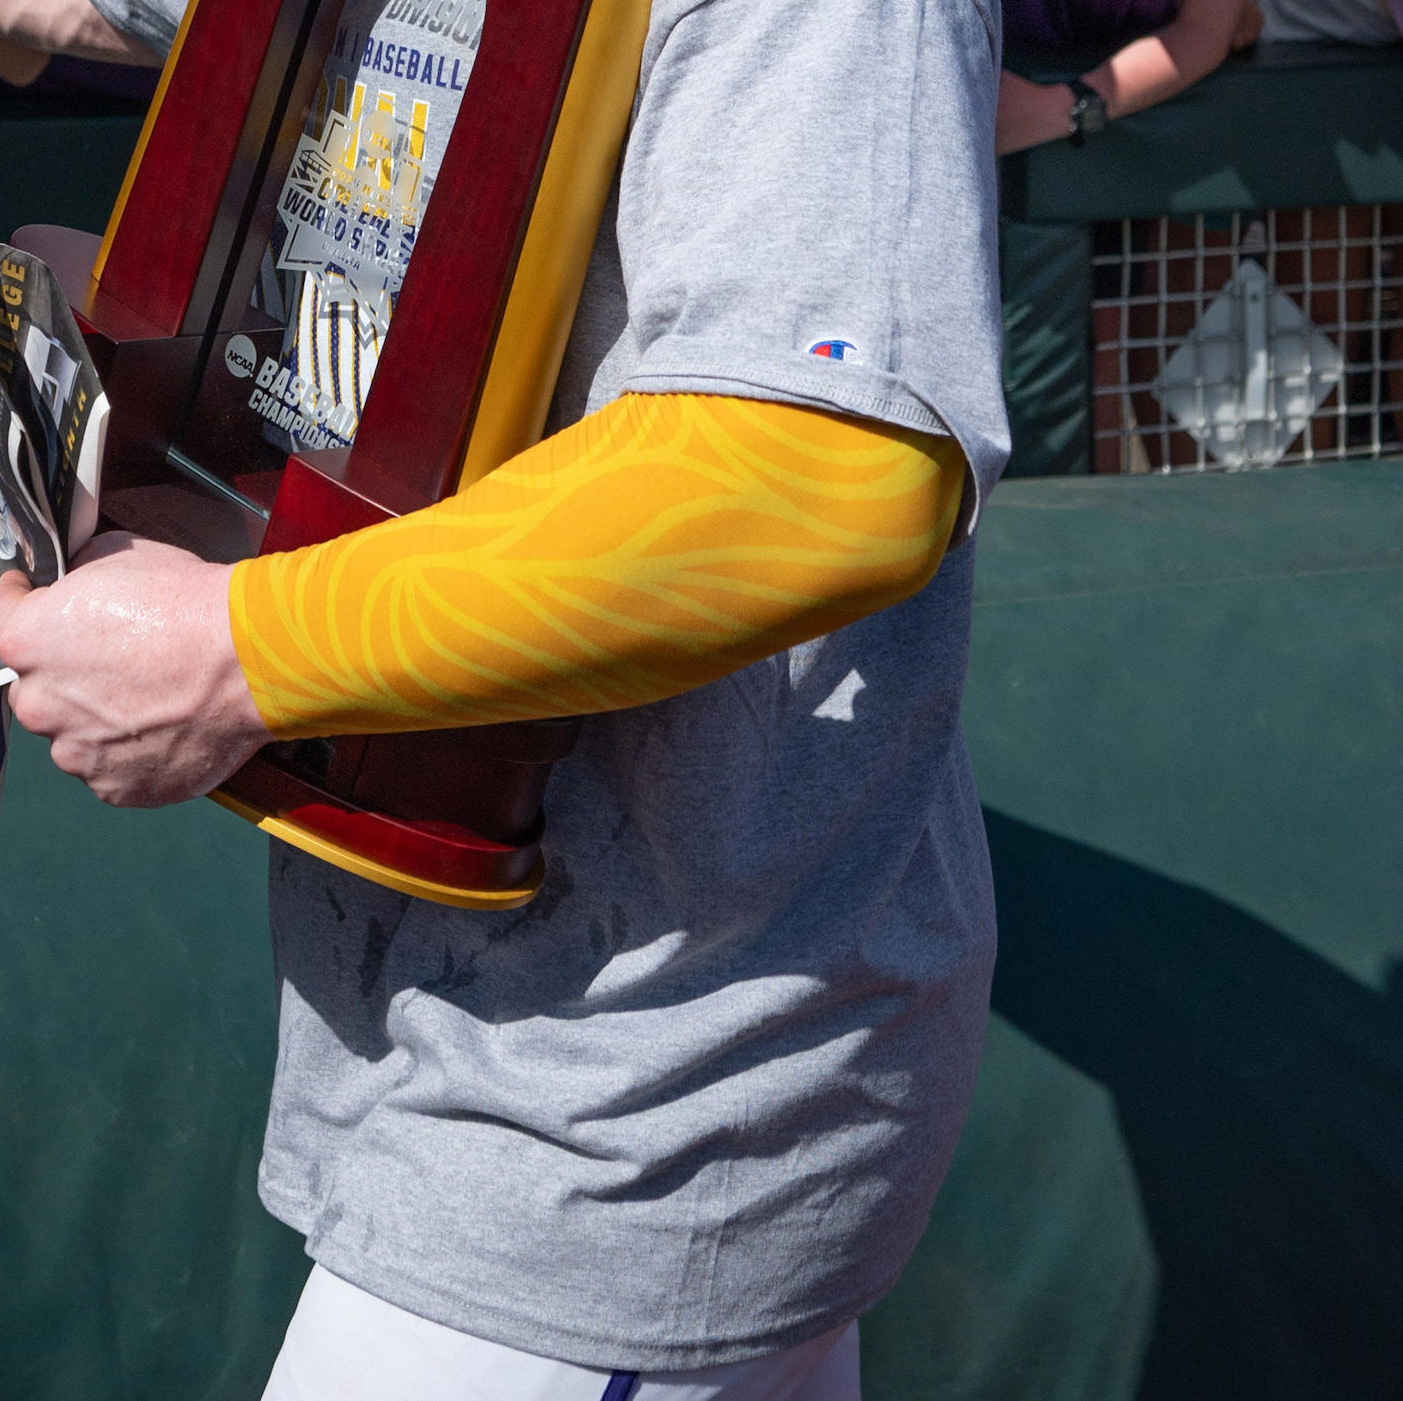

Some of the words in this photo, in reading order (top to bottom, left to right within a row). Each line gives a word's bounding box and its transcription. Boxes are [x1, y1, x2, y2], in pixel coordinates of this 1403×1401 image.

[362, 37, 462, 91] BASEBALL
[282, 187, 346, 242] WORLD
[227, 350, 254, 372] NCAA
[248, 389, 349, 449] CHAMPIONS
[255, 356, 357, 441] BASEBAL
